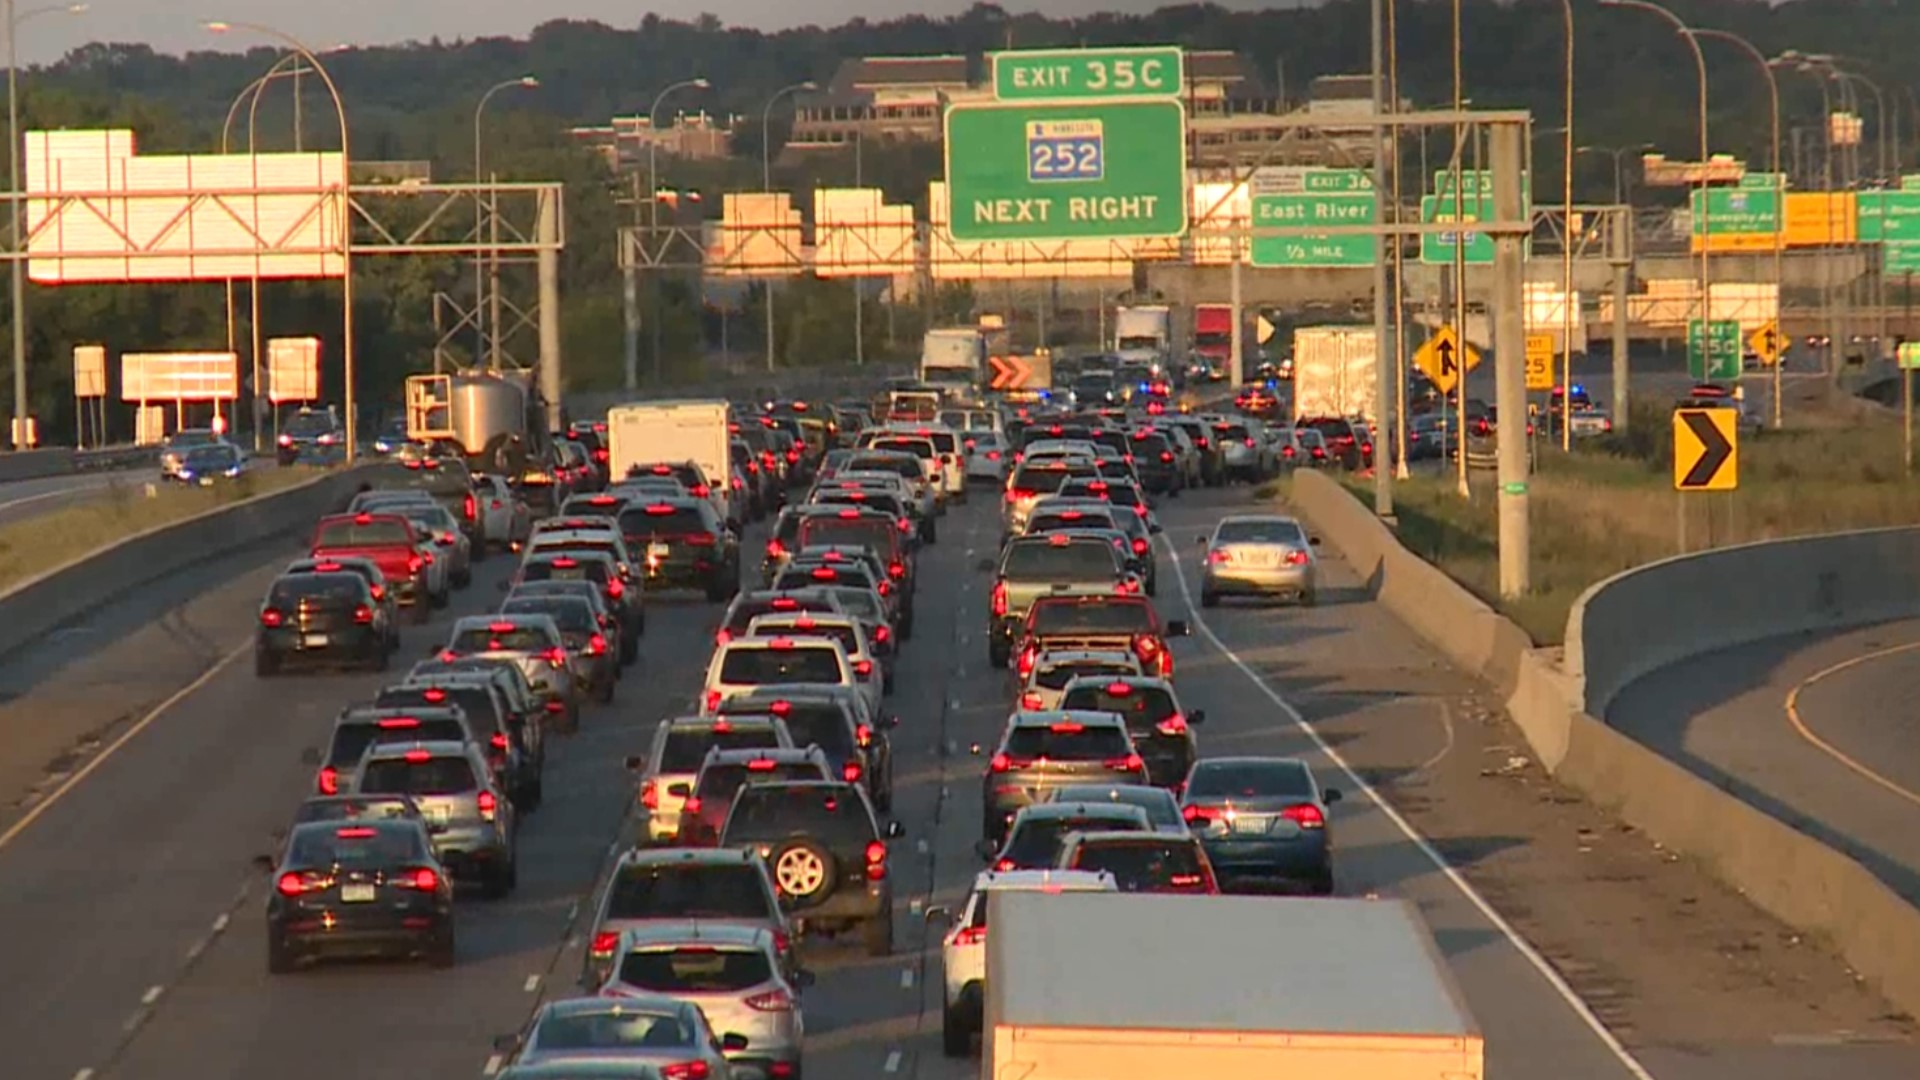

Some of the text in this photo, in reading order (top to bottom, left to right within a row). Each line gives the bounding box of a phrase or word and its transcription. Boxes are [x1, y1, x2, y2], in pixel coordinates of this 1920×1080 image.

[1013, 60, 1163, 89] EXIT 35C
[1034, 143, 1098, 173] 252
[1311, 176, 1340, 188] EXIT
[974, 195, 1158, 224] NEXT RIGHT
[1260, 203, 1369, 219] East River
[1312, 245, 1343, 258] MILE
